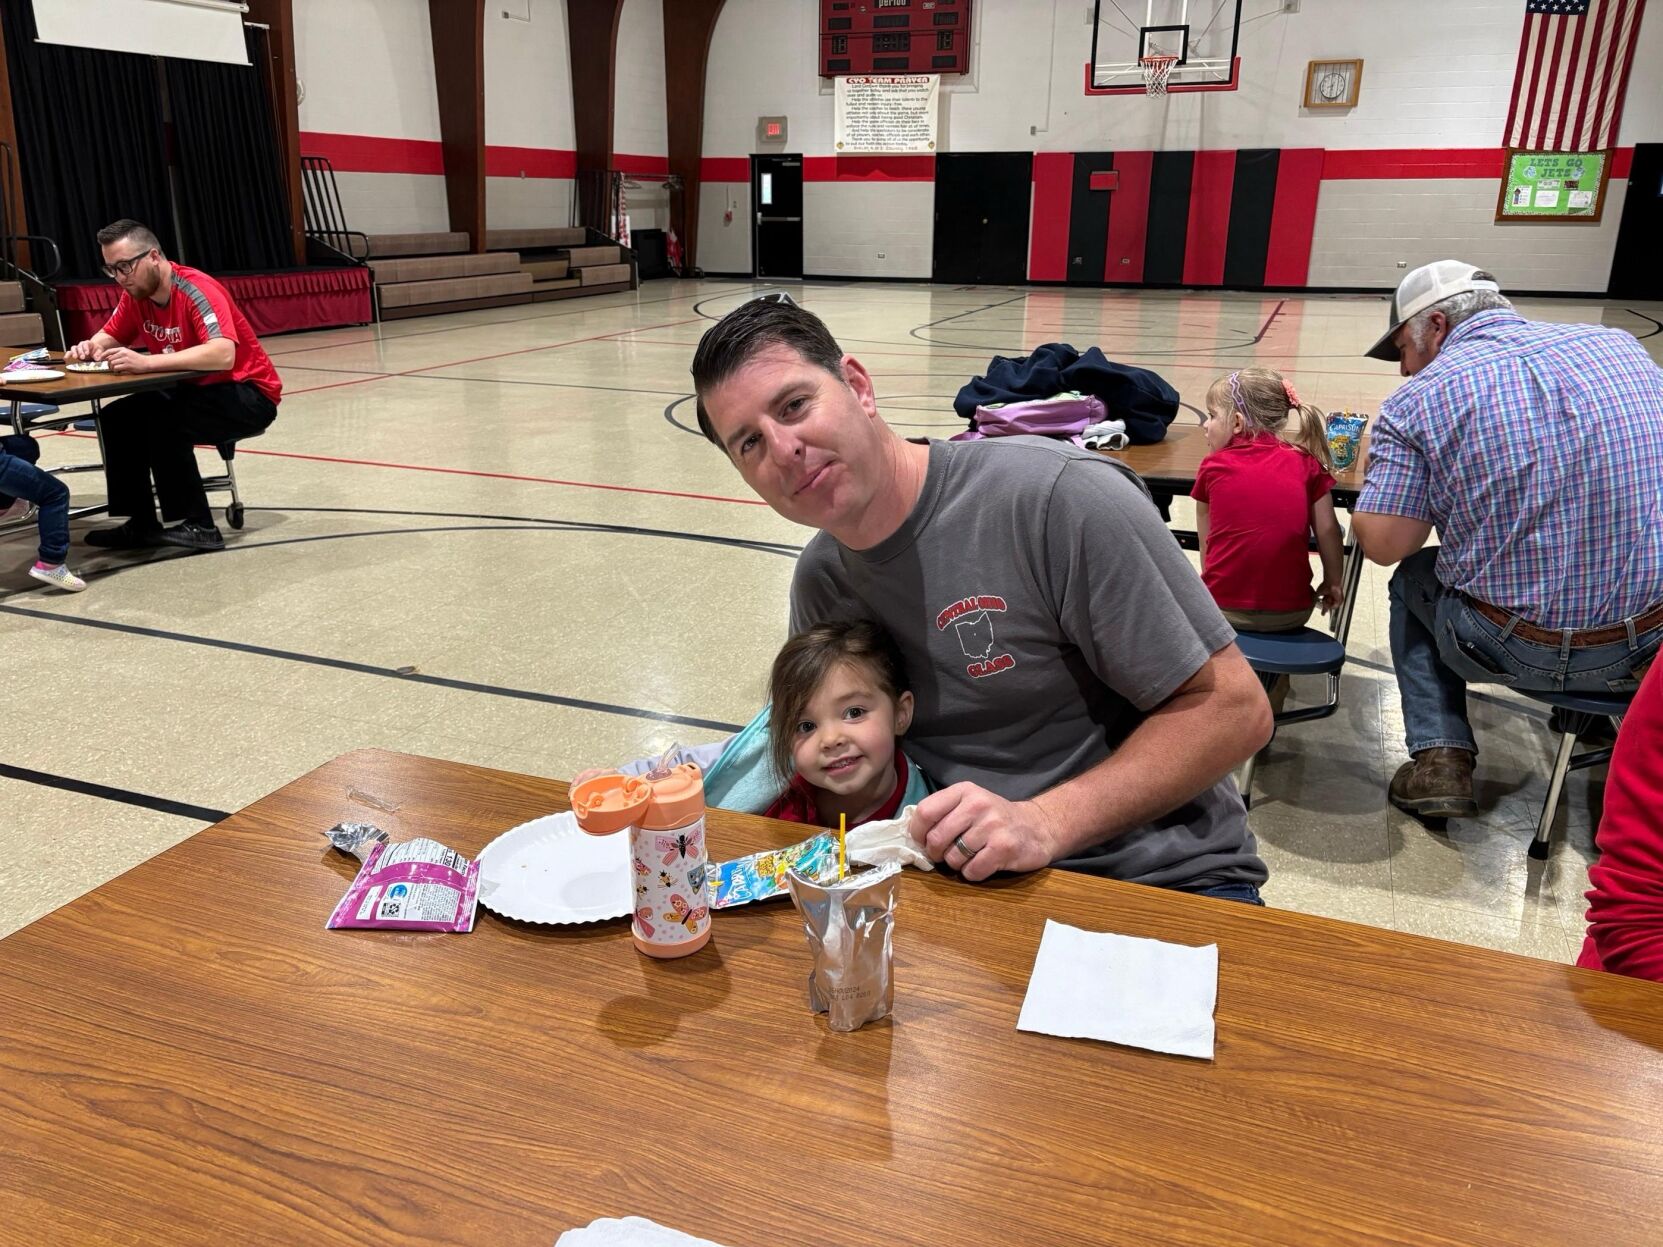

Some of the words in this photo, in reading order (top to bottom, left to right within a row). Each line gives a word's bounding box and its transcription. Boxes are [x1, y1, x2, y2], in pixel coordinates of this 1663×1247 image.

[1530, 158, 1560, 167] LETS
[1566, 158, 1583, 168] GO
[1541, 168, 1571, 178] JETS
[967, 654, 1016, 678] GLASS
